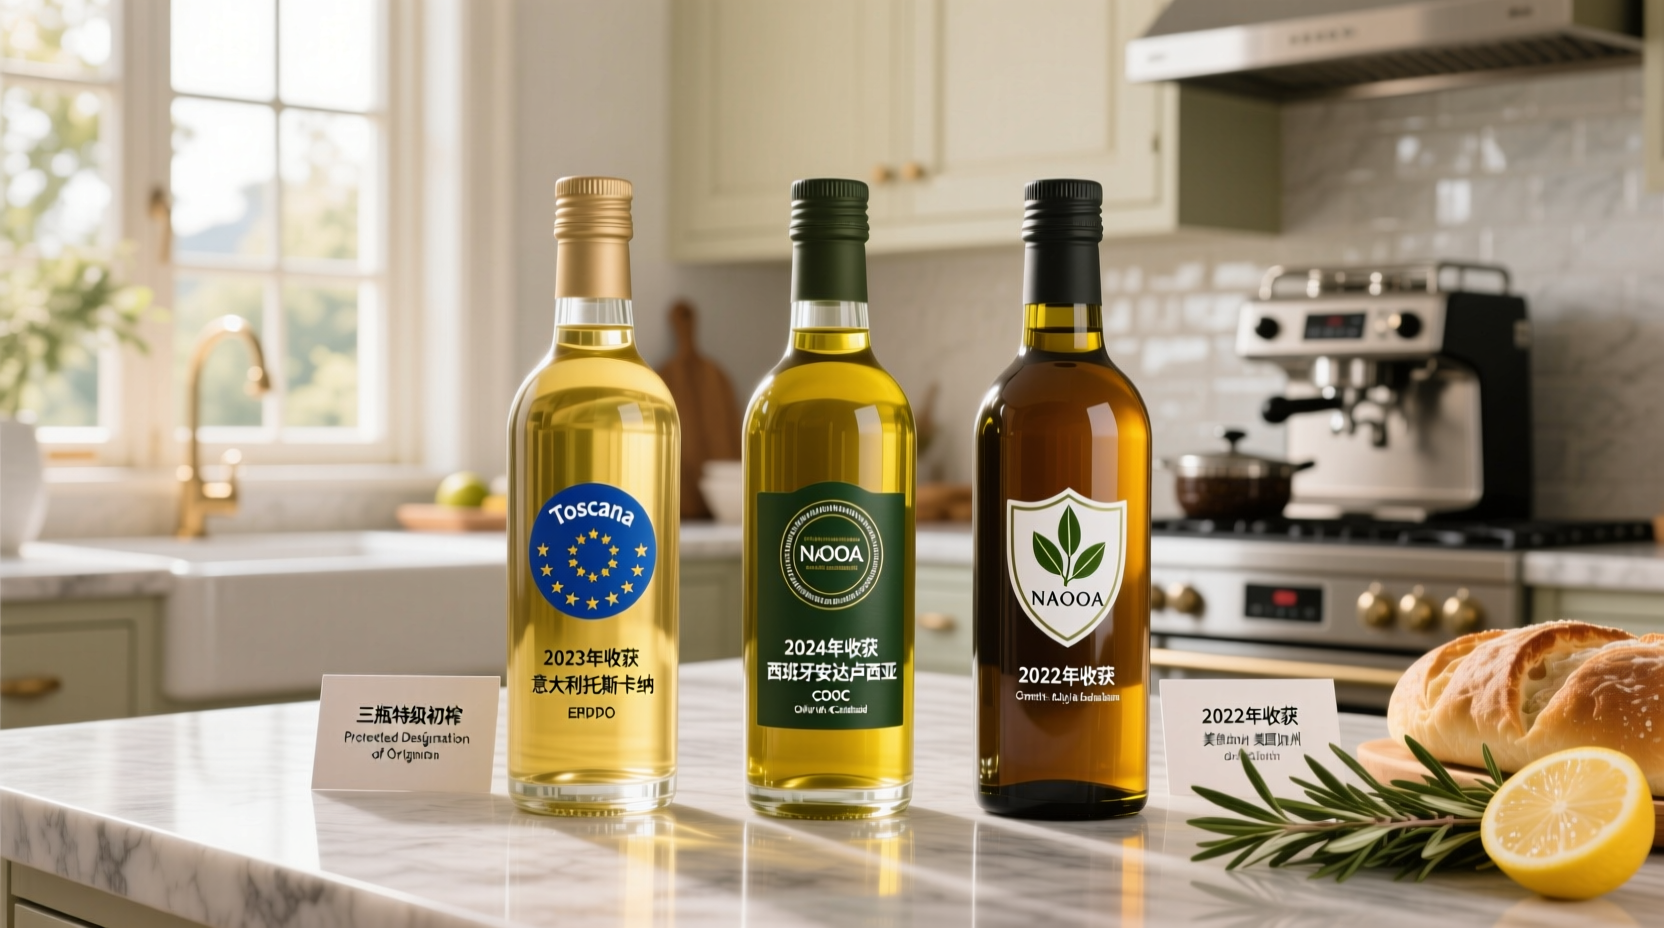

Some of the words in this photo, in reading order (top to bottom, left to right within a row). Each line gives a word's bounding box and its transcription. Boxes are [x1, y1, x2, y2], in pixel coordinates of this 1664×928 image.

[549, 501, 635, 527] Toscana
[1031, 591, 1104, 606] NAOOA
[543, 648, 639, 668] 2023年收获
[784, 638, 878, 659] 2024年收获
[767, 662, 897, 682] 西班牙安达卢西亚
[1018, 666, 1115, 687] 2022年收获
[532, 674, 654, 695] 意大利托斯卡纳
[812, 689, 850, 702] COOC
[1202, 706, 1299, 726] 2022年收获
